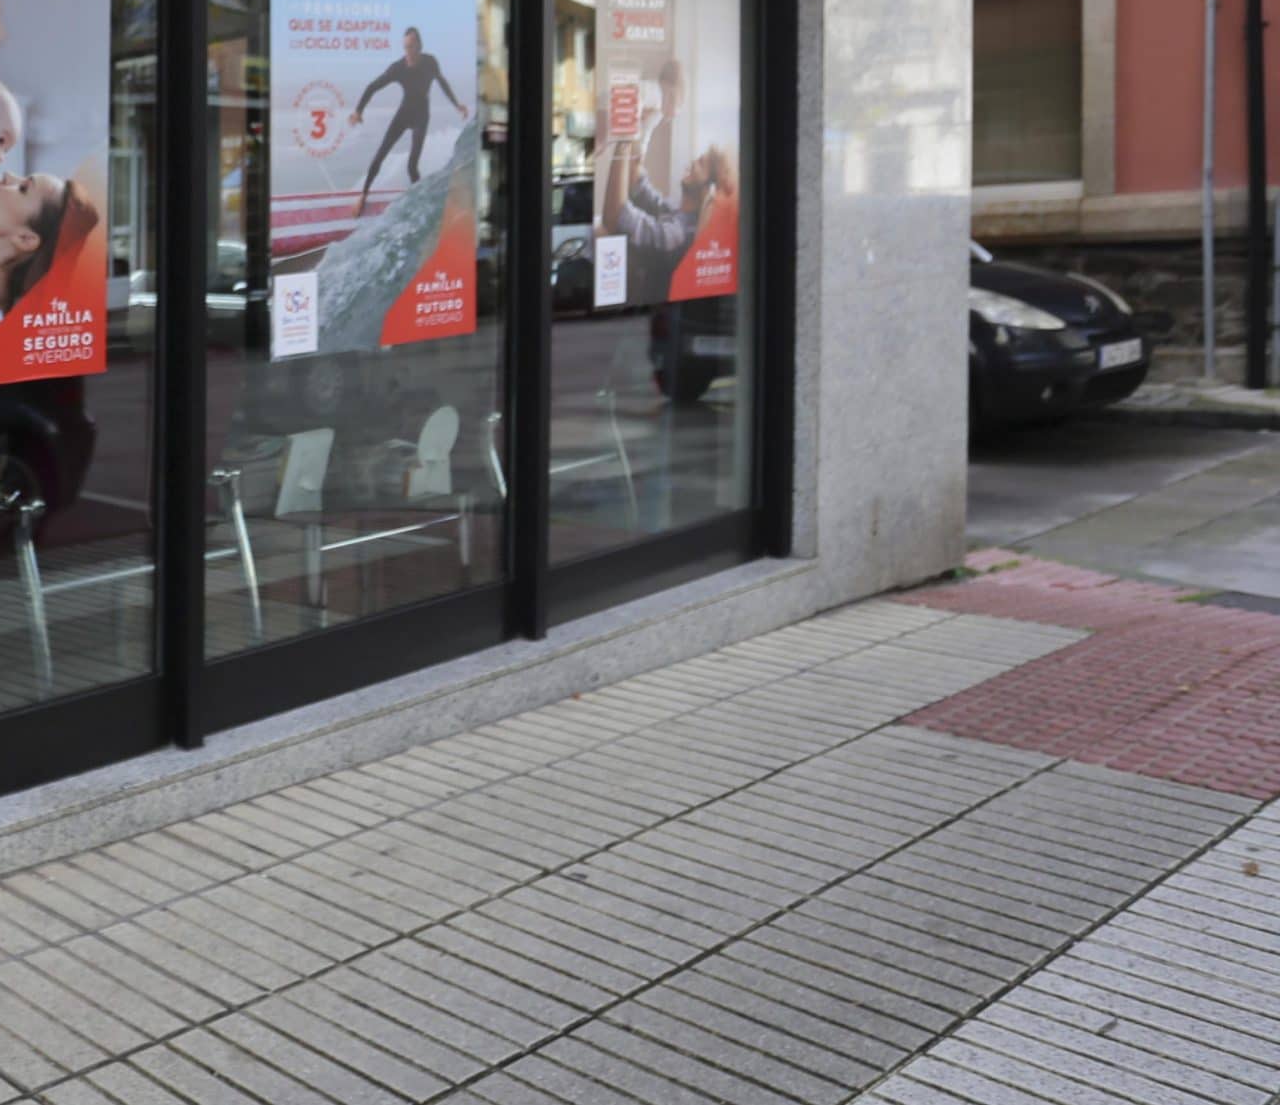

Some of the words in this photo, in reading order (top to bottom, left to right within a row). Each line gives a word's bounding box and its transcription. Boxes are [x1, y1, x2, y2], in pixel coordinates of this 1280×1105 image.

[416, 298, 464, 314] FUTURO
[22, 309, 94, 329] FAMILIA
[22, 332, 94, 352] SEGURO
